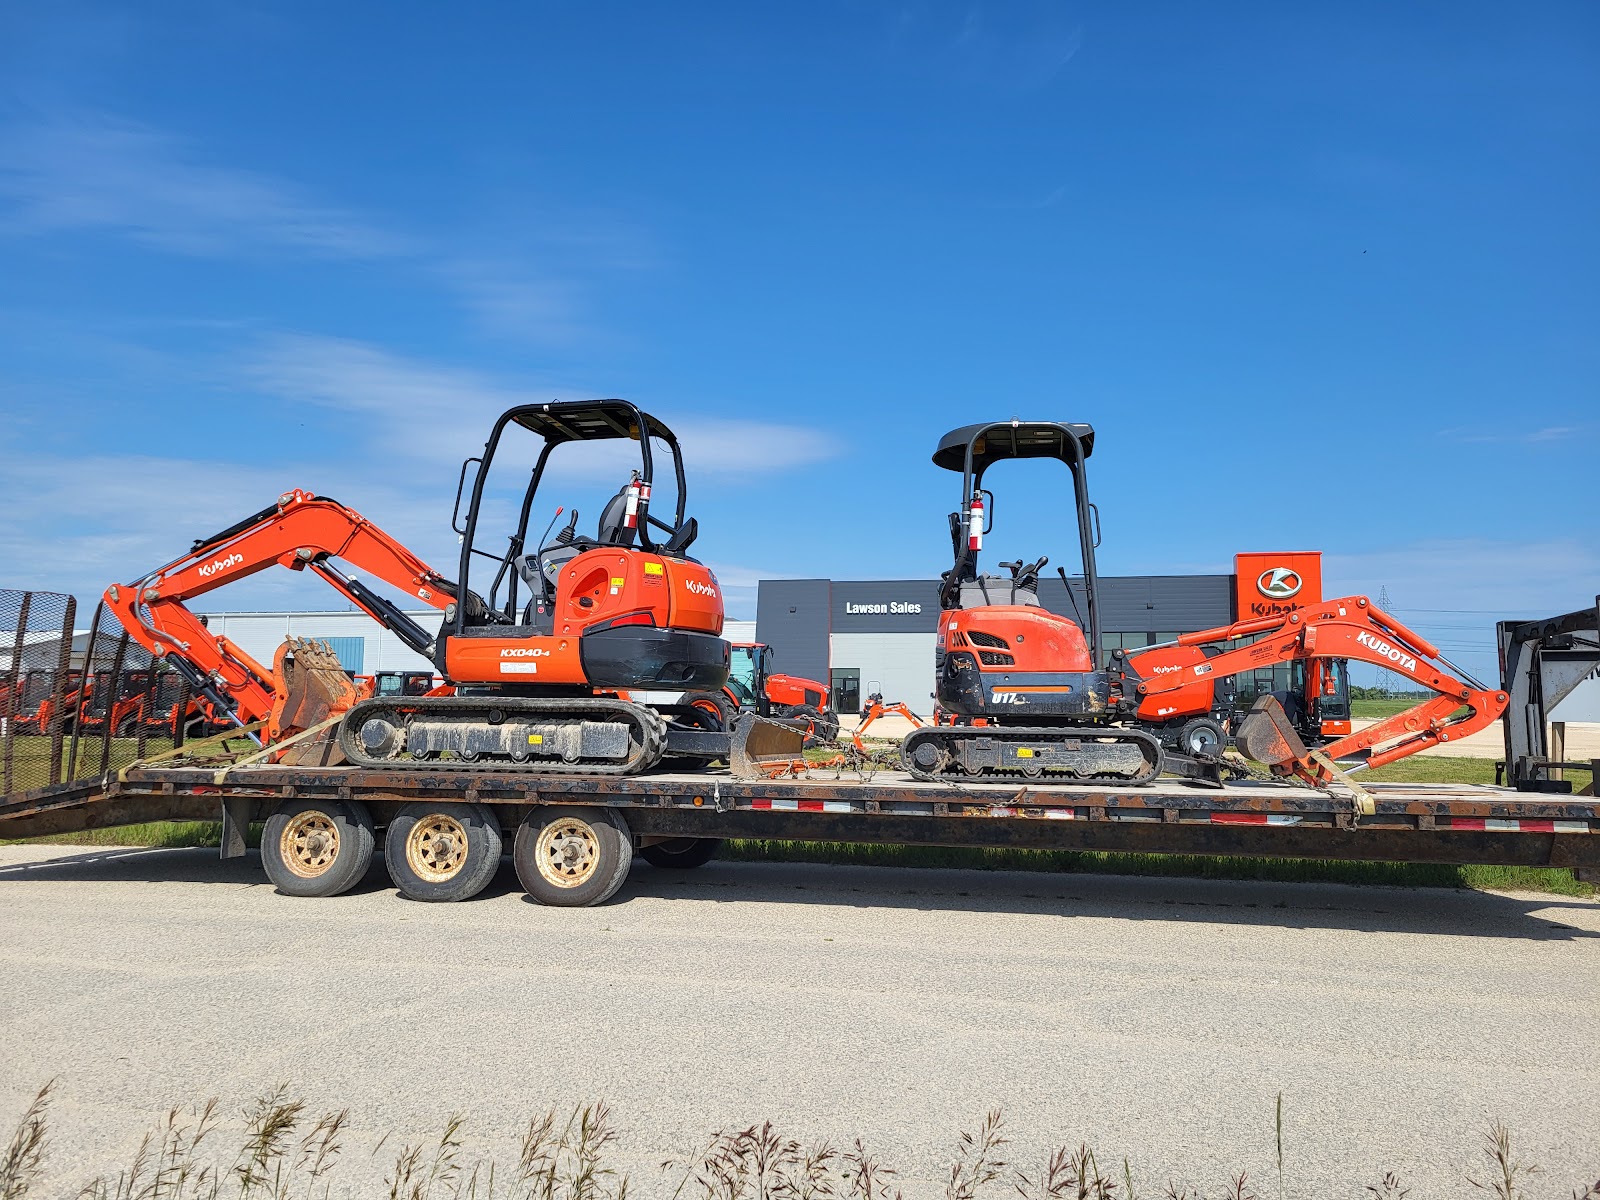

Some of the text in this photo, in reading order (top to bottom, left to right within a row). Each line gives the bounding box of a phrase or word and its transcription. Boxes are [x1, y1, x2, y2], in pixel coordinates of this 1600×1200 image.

[198, 553, 244, 577] Kubota
[685, 579, 717, 598] Kubota
[846, 601, 922, 615] Lawson Sales
[500, 648, 551, 657] KX040-4
[1356, 631, 1417, 672] KUBOTA
